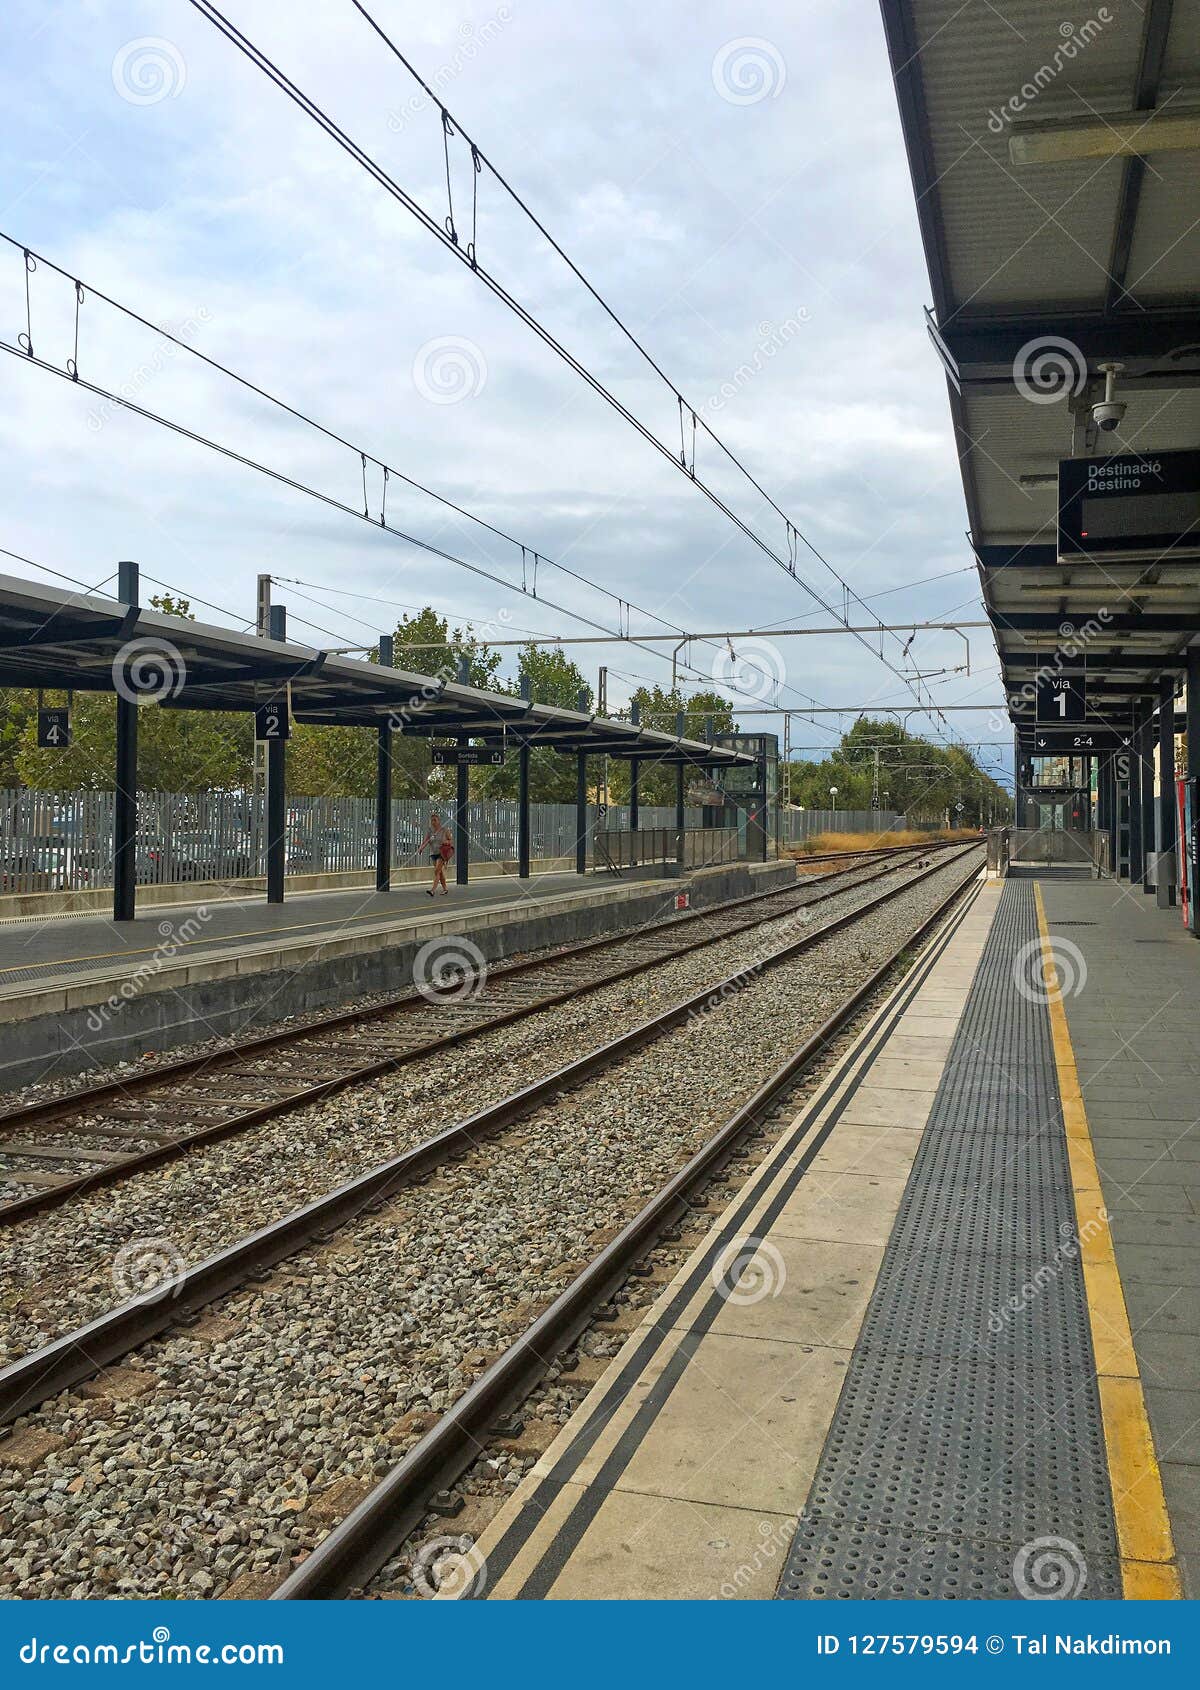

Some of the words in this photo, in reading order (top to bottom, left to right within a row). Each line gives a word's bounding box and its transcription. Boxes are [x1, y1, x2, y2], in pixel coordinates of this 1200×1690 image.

[1088, 460, 1161, 478] Destinació
[1088, 478, 1141, 492] Destino
[1052, 679, 1071, 689] via
[265, 704, 279, 714] via
[1053, 692, 1066, 717] 1
[47, 714, 59, 723] via
[266, 715, 280, 736] 2
[46, 724, 60, 744] 4
[1073, 737, 1094, 747] 2-4
